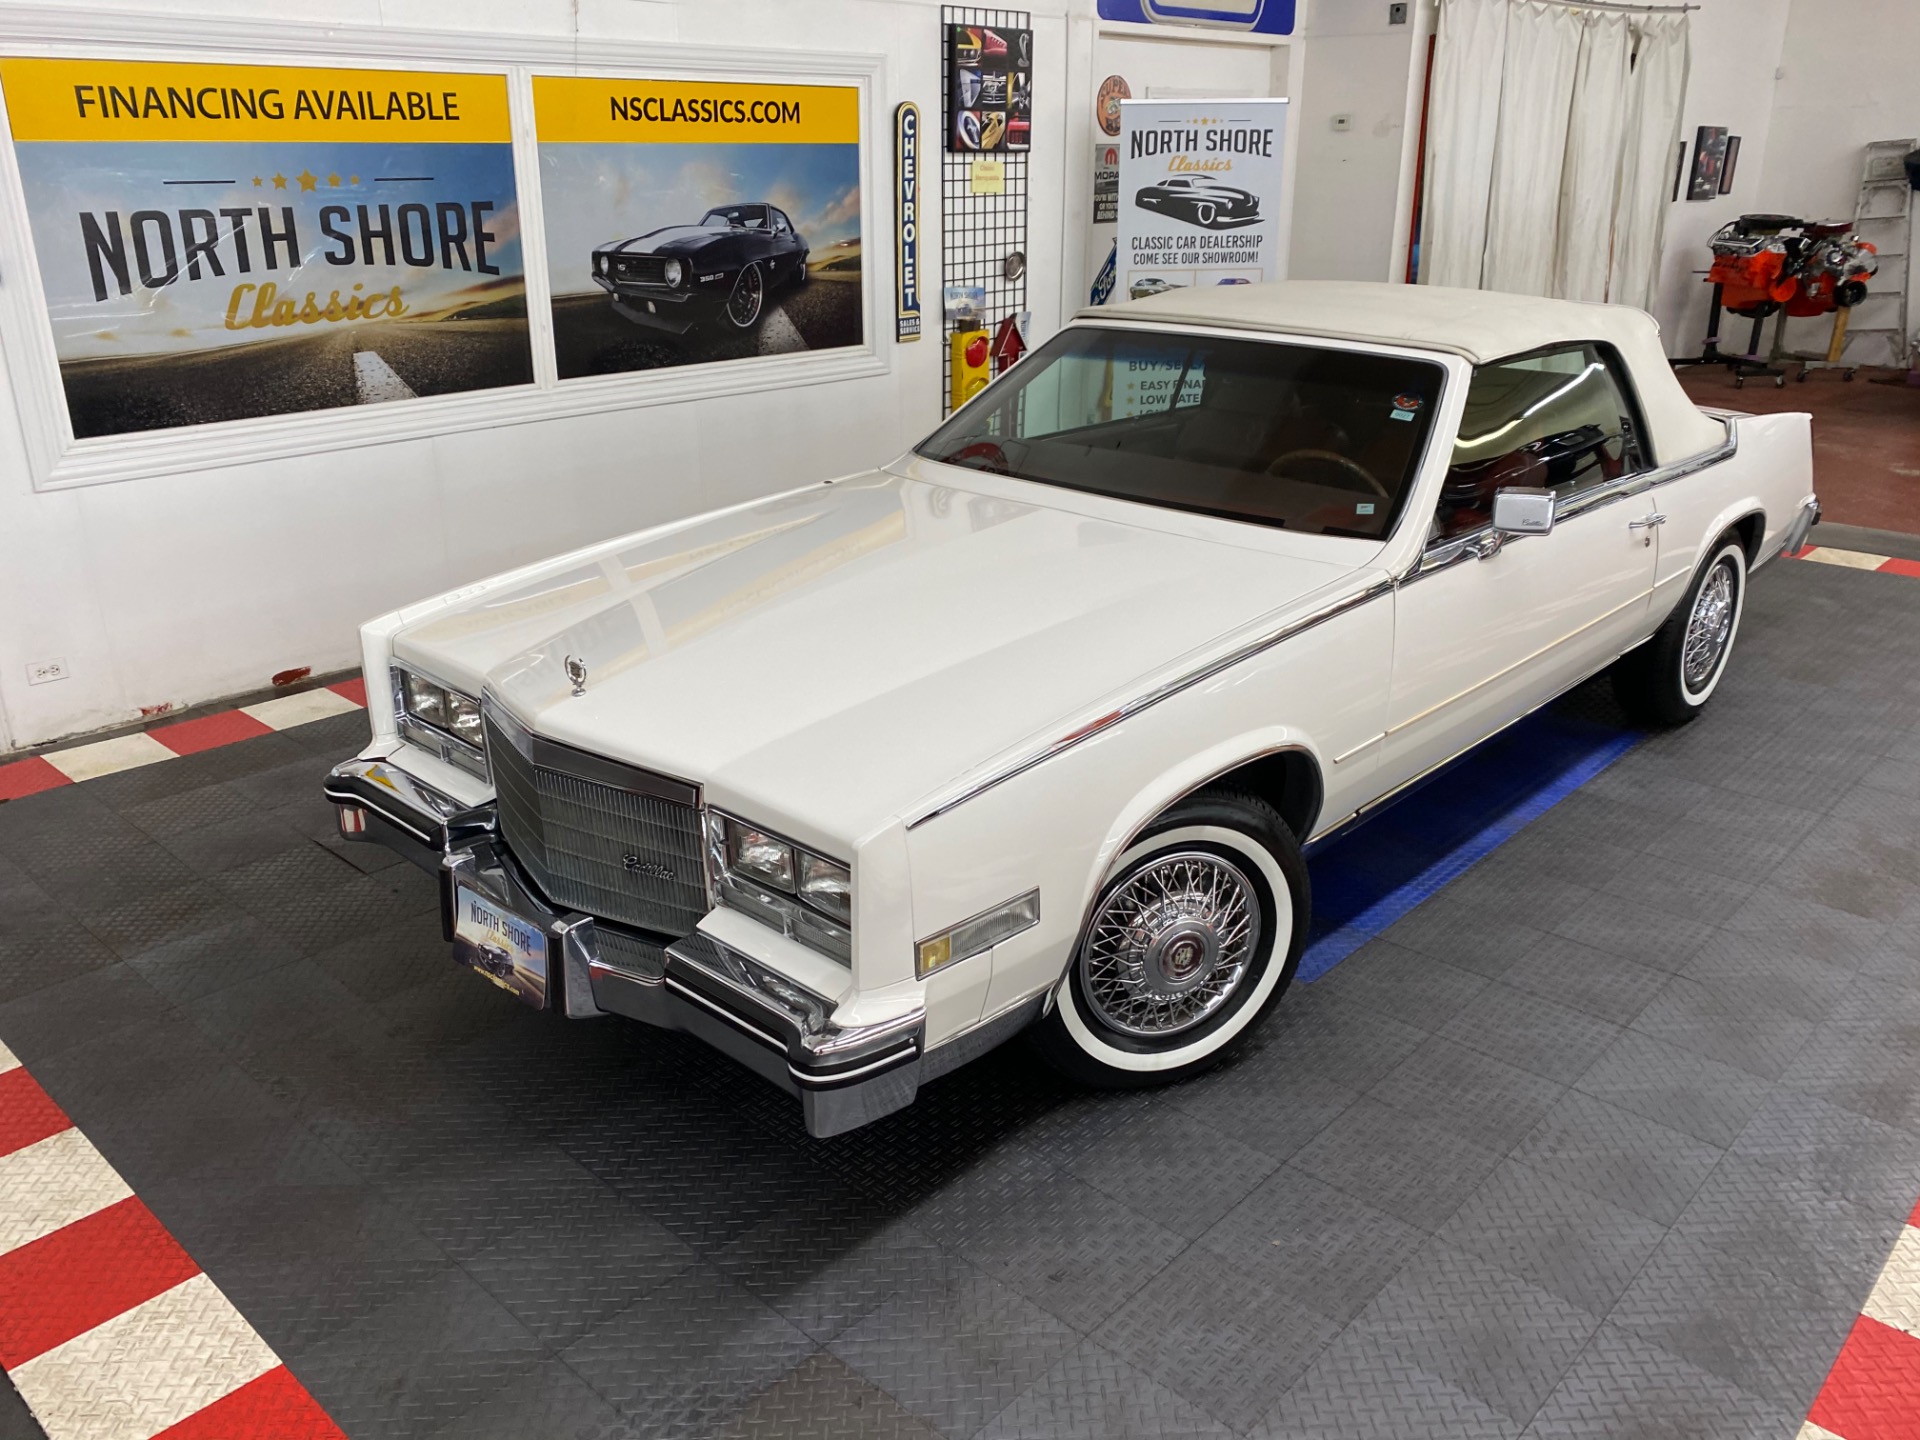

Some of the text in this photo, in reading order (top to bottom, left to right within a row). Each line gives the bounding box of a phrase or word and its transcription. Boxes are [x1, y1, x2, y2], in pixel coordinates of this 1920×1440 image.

[74, 85, 460, 121] FINANCING AVAILABLE
[610, 96, 800, 124] NSCLASSICS.COM
[1131, 129, 1274, 159] NORTH SHORE
[1095, 171, 1119, 180] MOPA
[1167, 155, 1232, 173] Classics
[903, 115, 916, 307] CHEVROLET
[79, 200, 500, 303] NORTH SHORE
[1131, 234, 1263, 250] CLASSIC CAR DEALERSHIP
[1133, 251, 1259, 265] COME SEE OUR SHOWROOM!
[225, 282, 410, 331] Classics
[1140, 380, 1170, 391] EASY
[1140, 394, 1167, 405] LOW
[622, 854, 675, 881] Cadillac
[471, 903, 531, 956] NORTH SHORE
